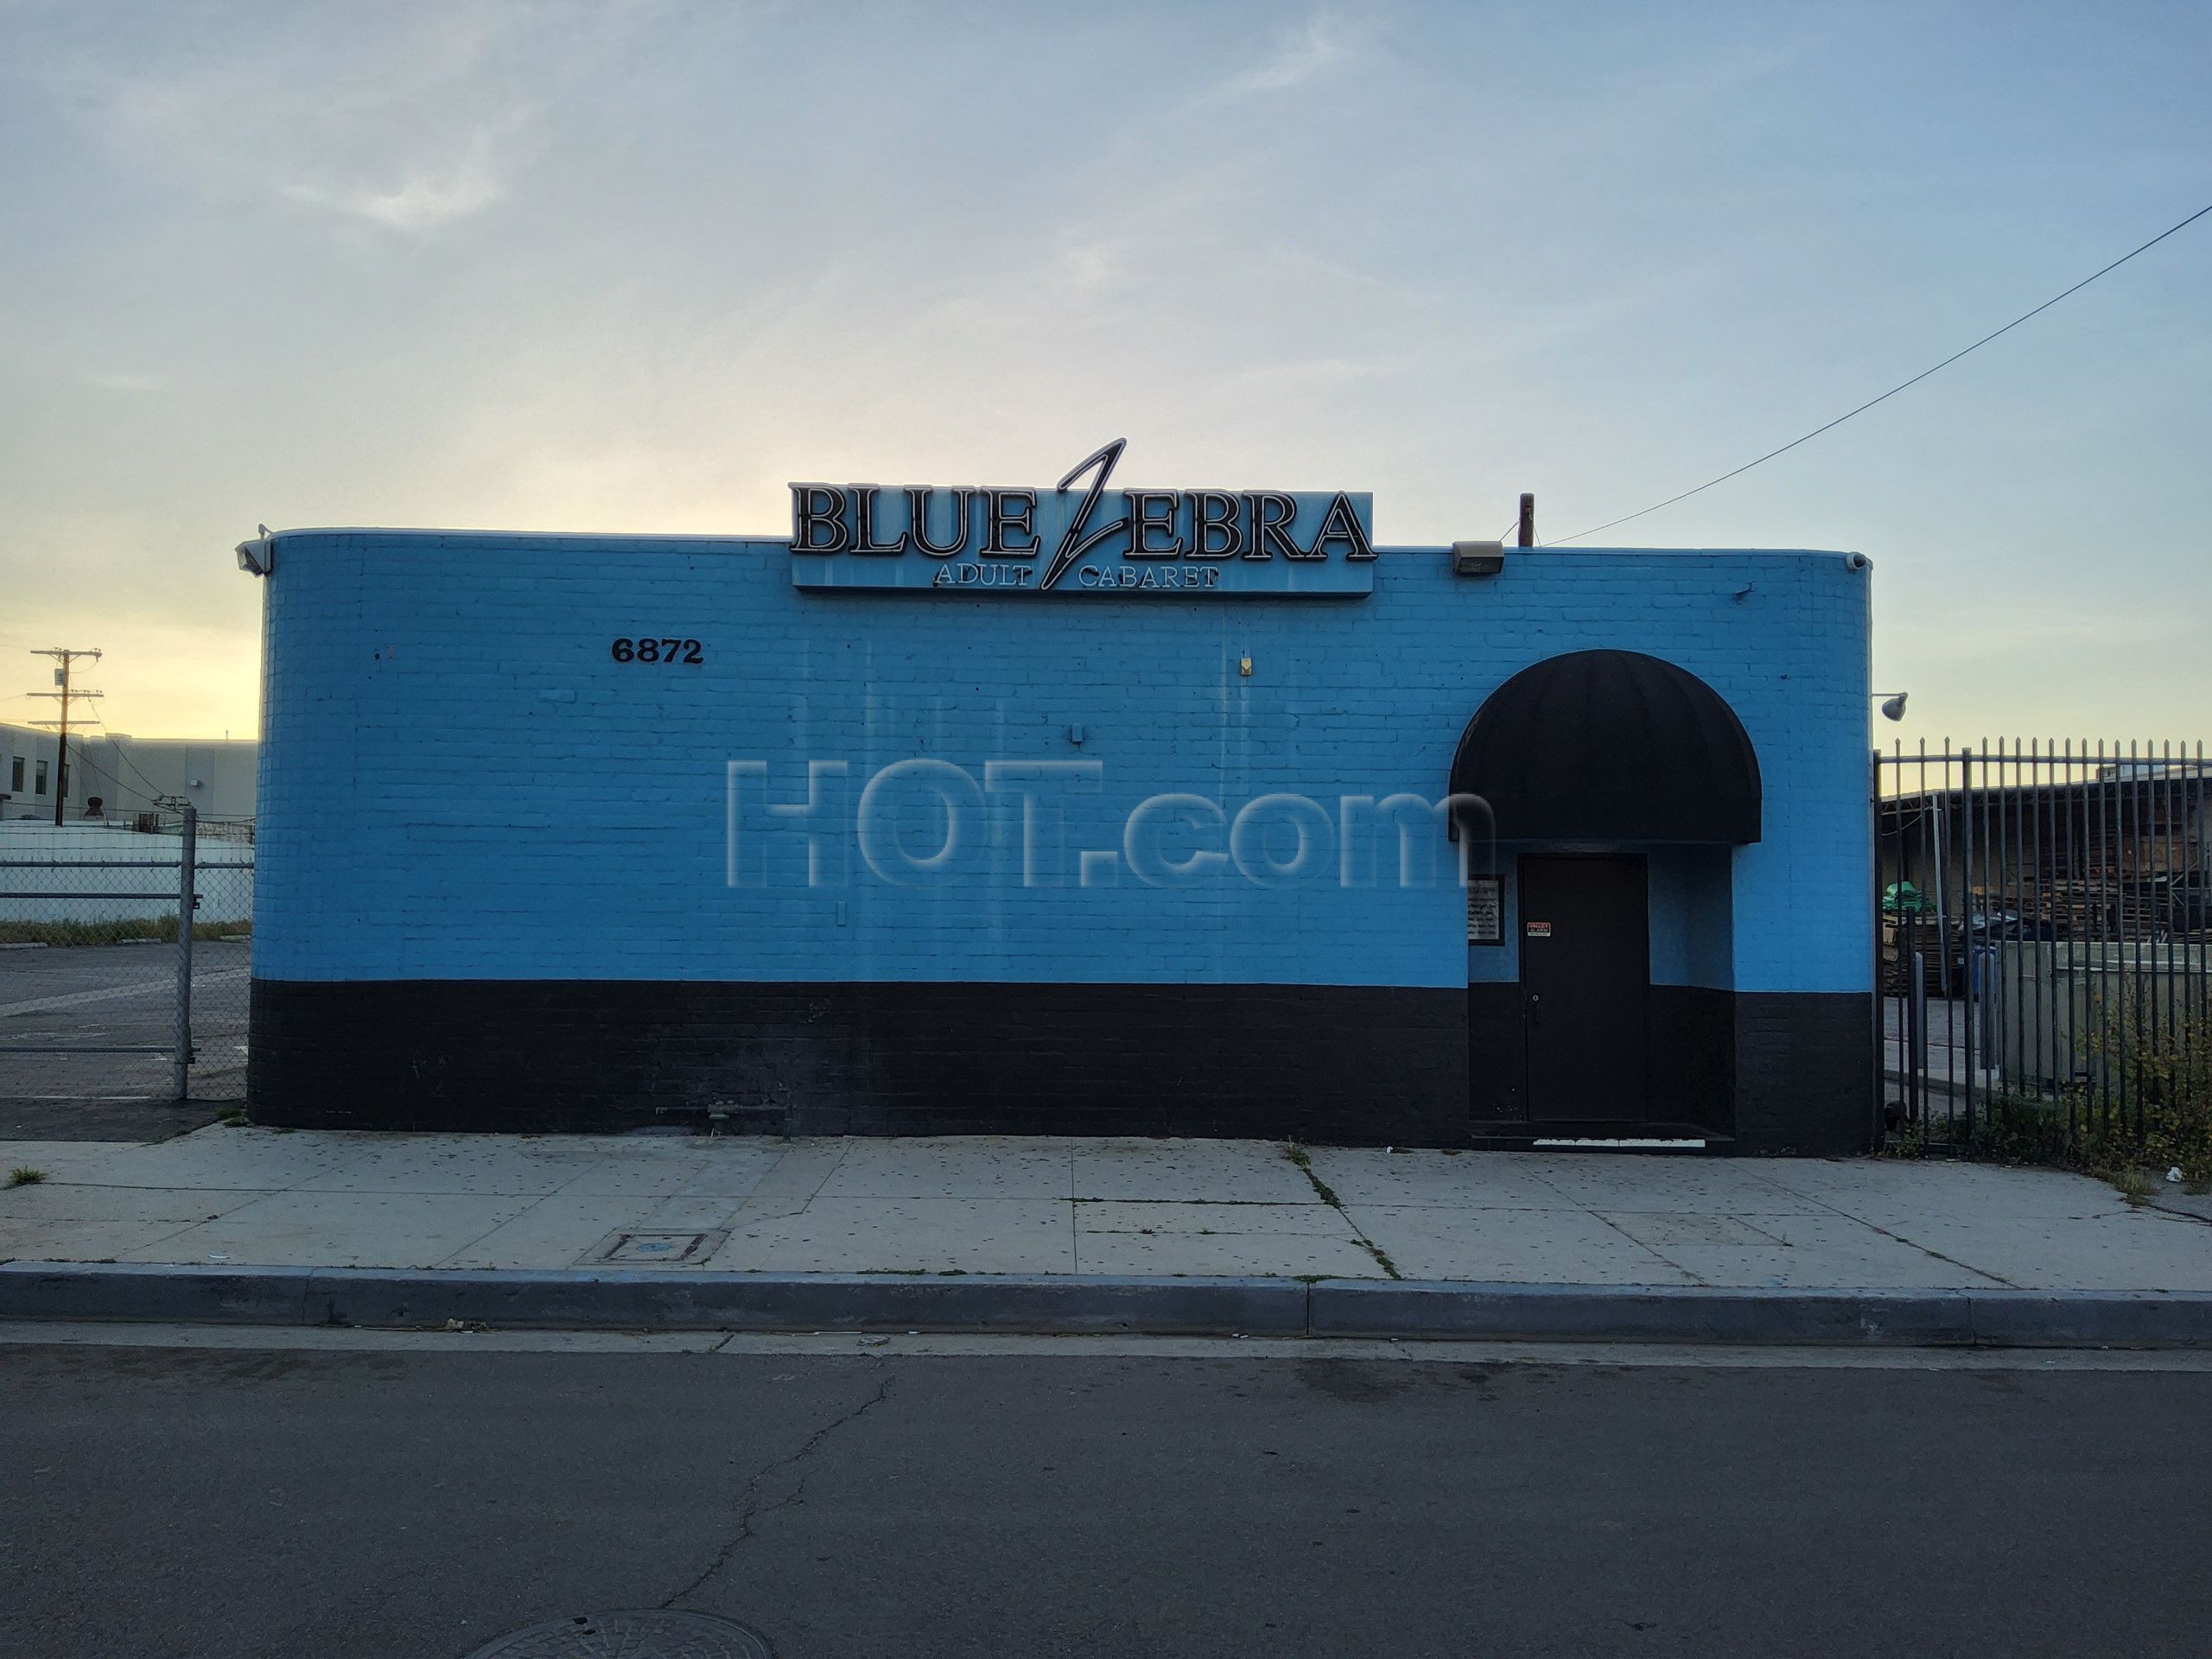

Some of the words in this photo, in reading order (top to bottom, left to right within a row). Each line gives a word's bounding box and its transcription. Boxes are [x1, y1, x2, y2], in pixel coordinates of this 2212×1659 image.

[788, 482, 1039, 557] BLUE
[935, 563, 1033, 587] ADULT
[1078, 565, 1219, 588] CABARET
[611, 638, 704, 664] 6872
